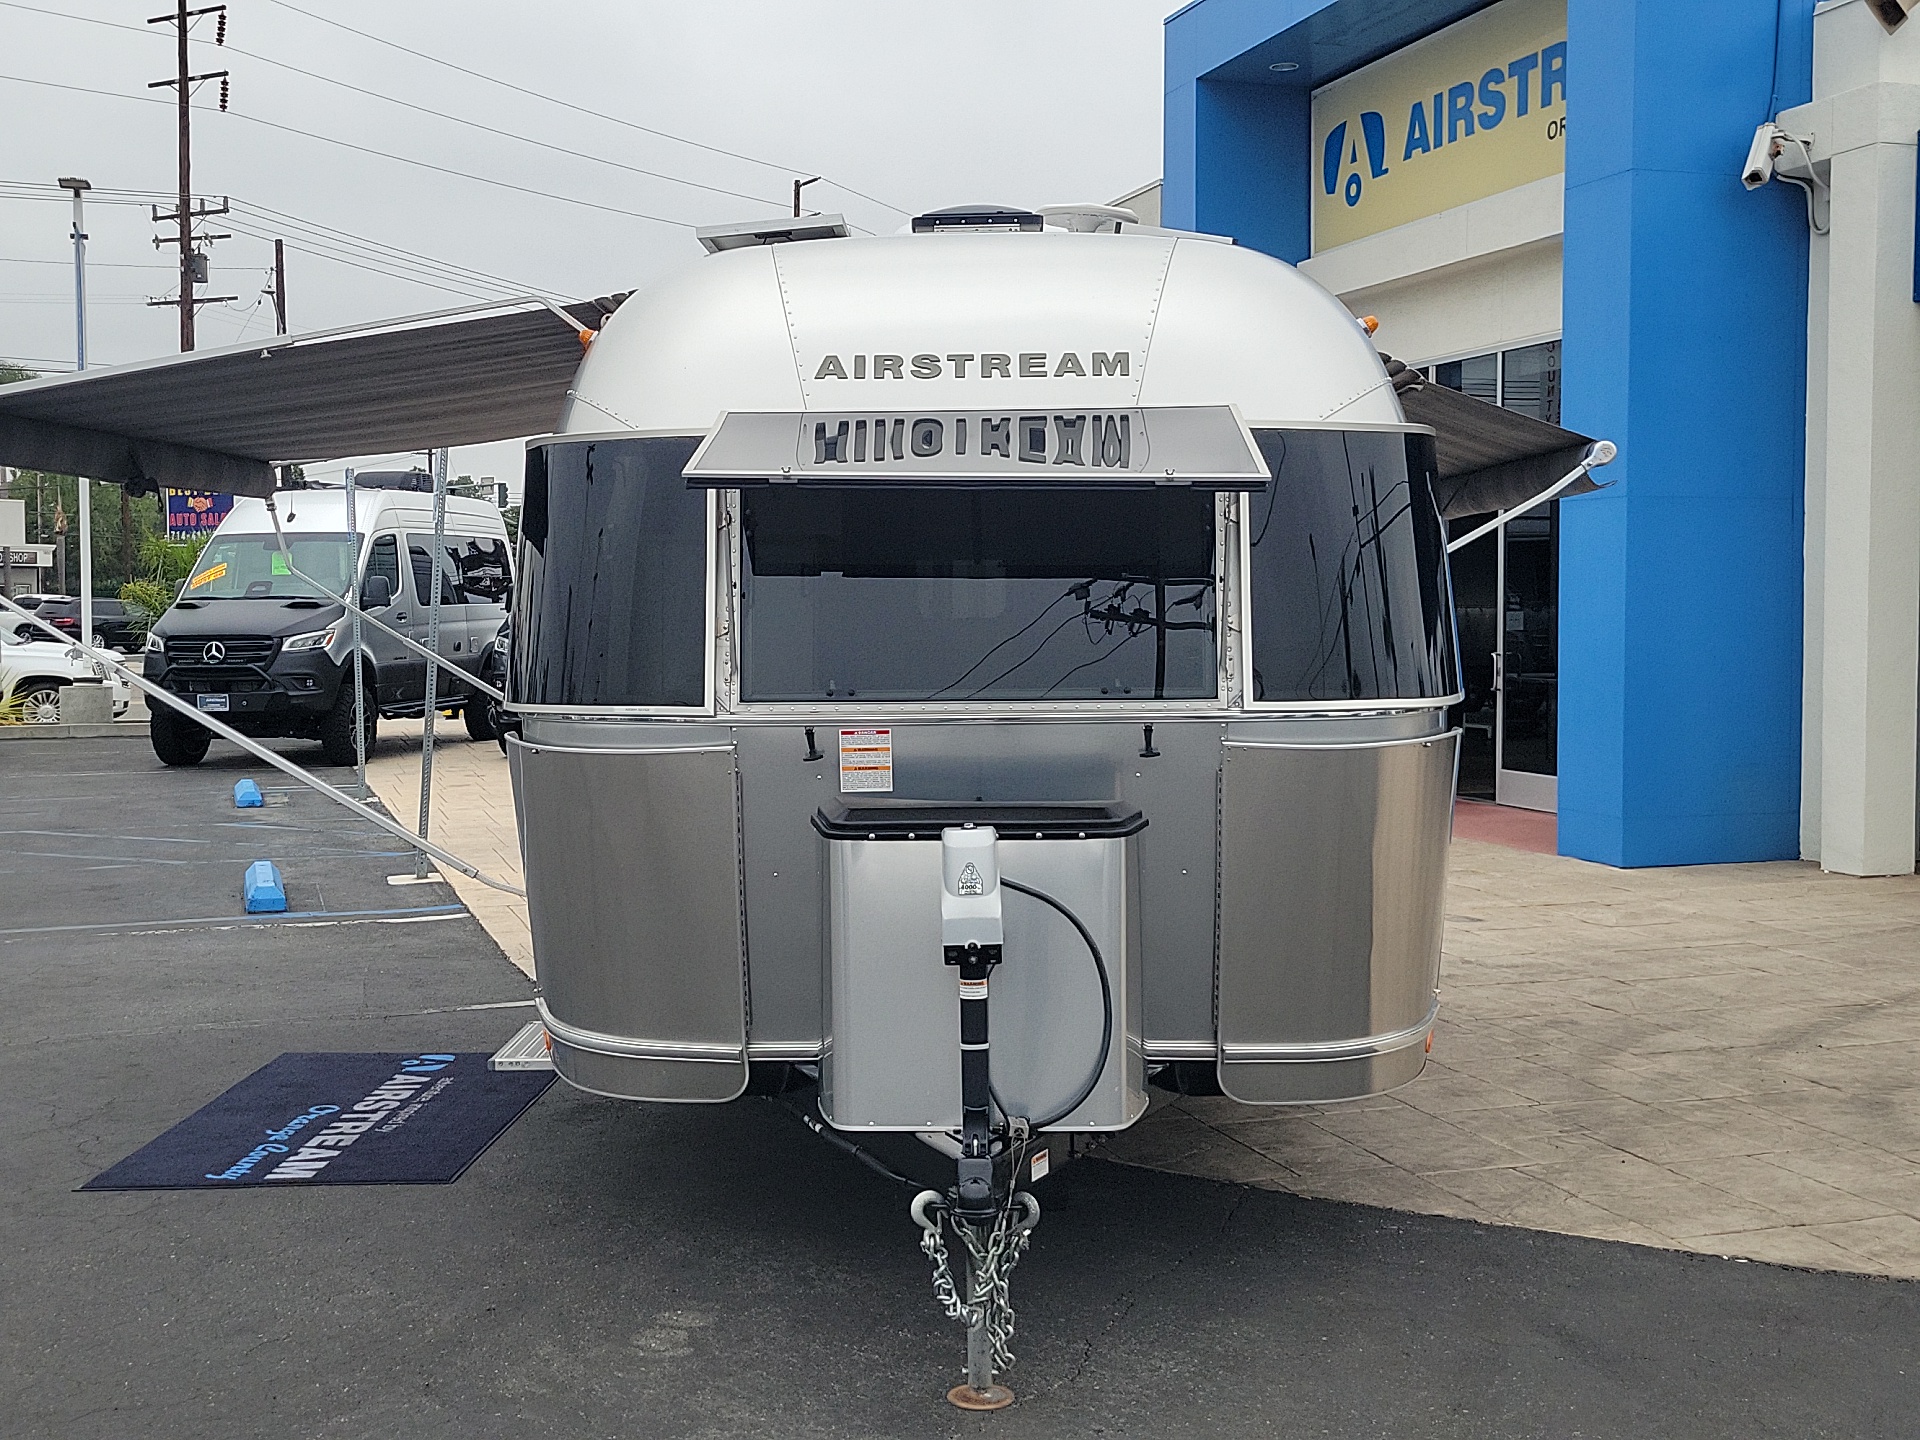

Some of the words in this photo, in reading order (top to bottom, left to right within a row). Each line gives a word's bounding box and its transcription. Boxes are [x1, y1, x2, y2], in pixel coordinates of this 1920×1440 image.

[1402, 41, 1566, 161] AIRSTR
[814, 352, 1130, 379] AIRSTREAM
[169, 513, 197, 527] AUTO
[10, 552, 28, 563] SHOP
[263, 1074, 432, 1180] AIRSTREAM
[266, 1104, 341, 1141] Orange
[205, 1143, 289, 1180] County
